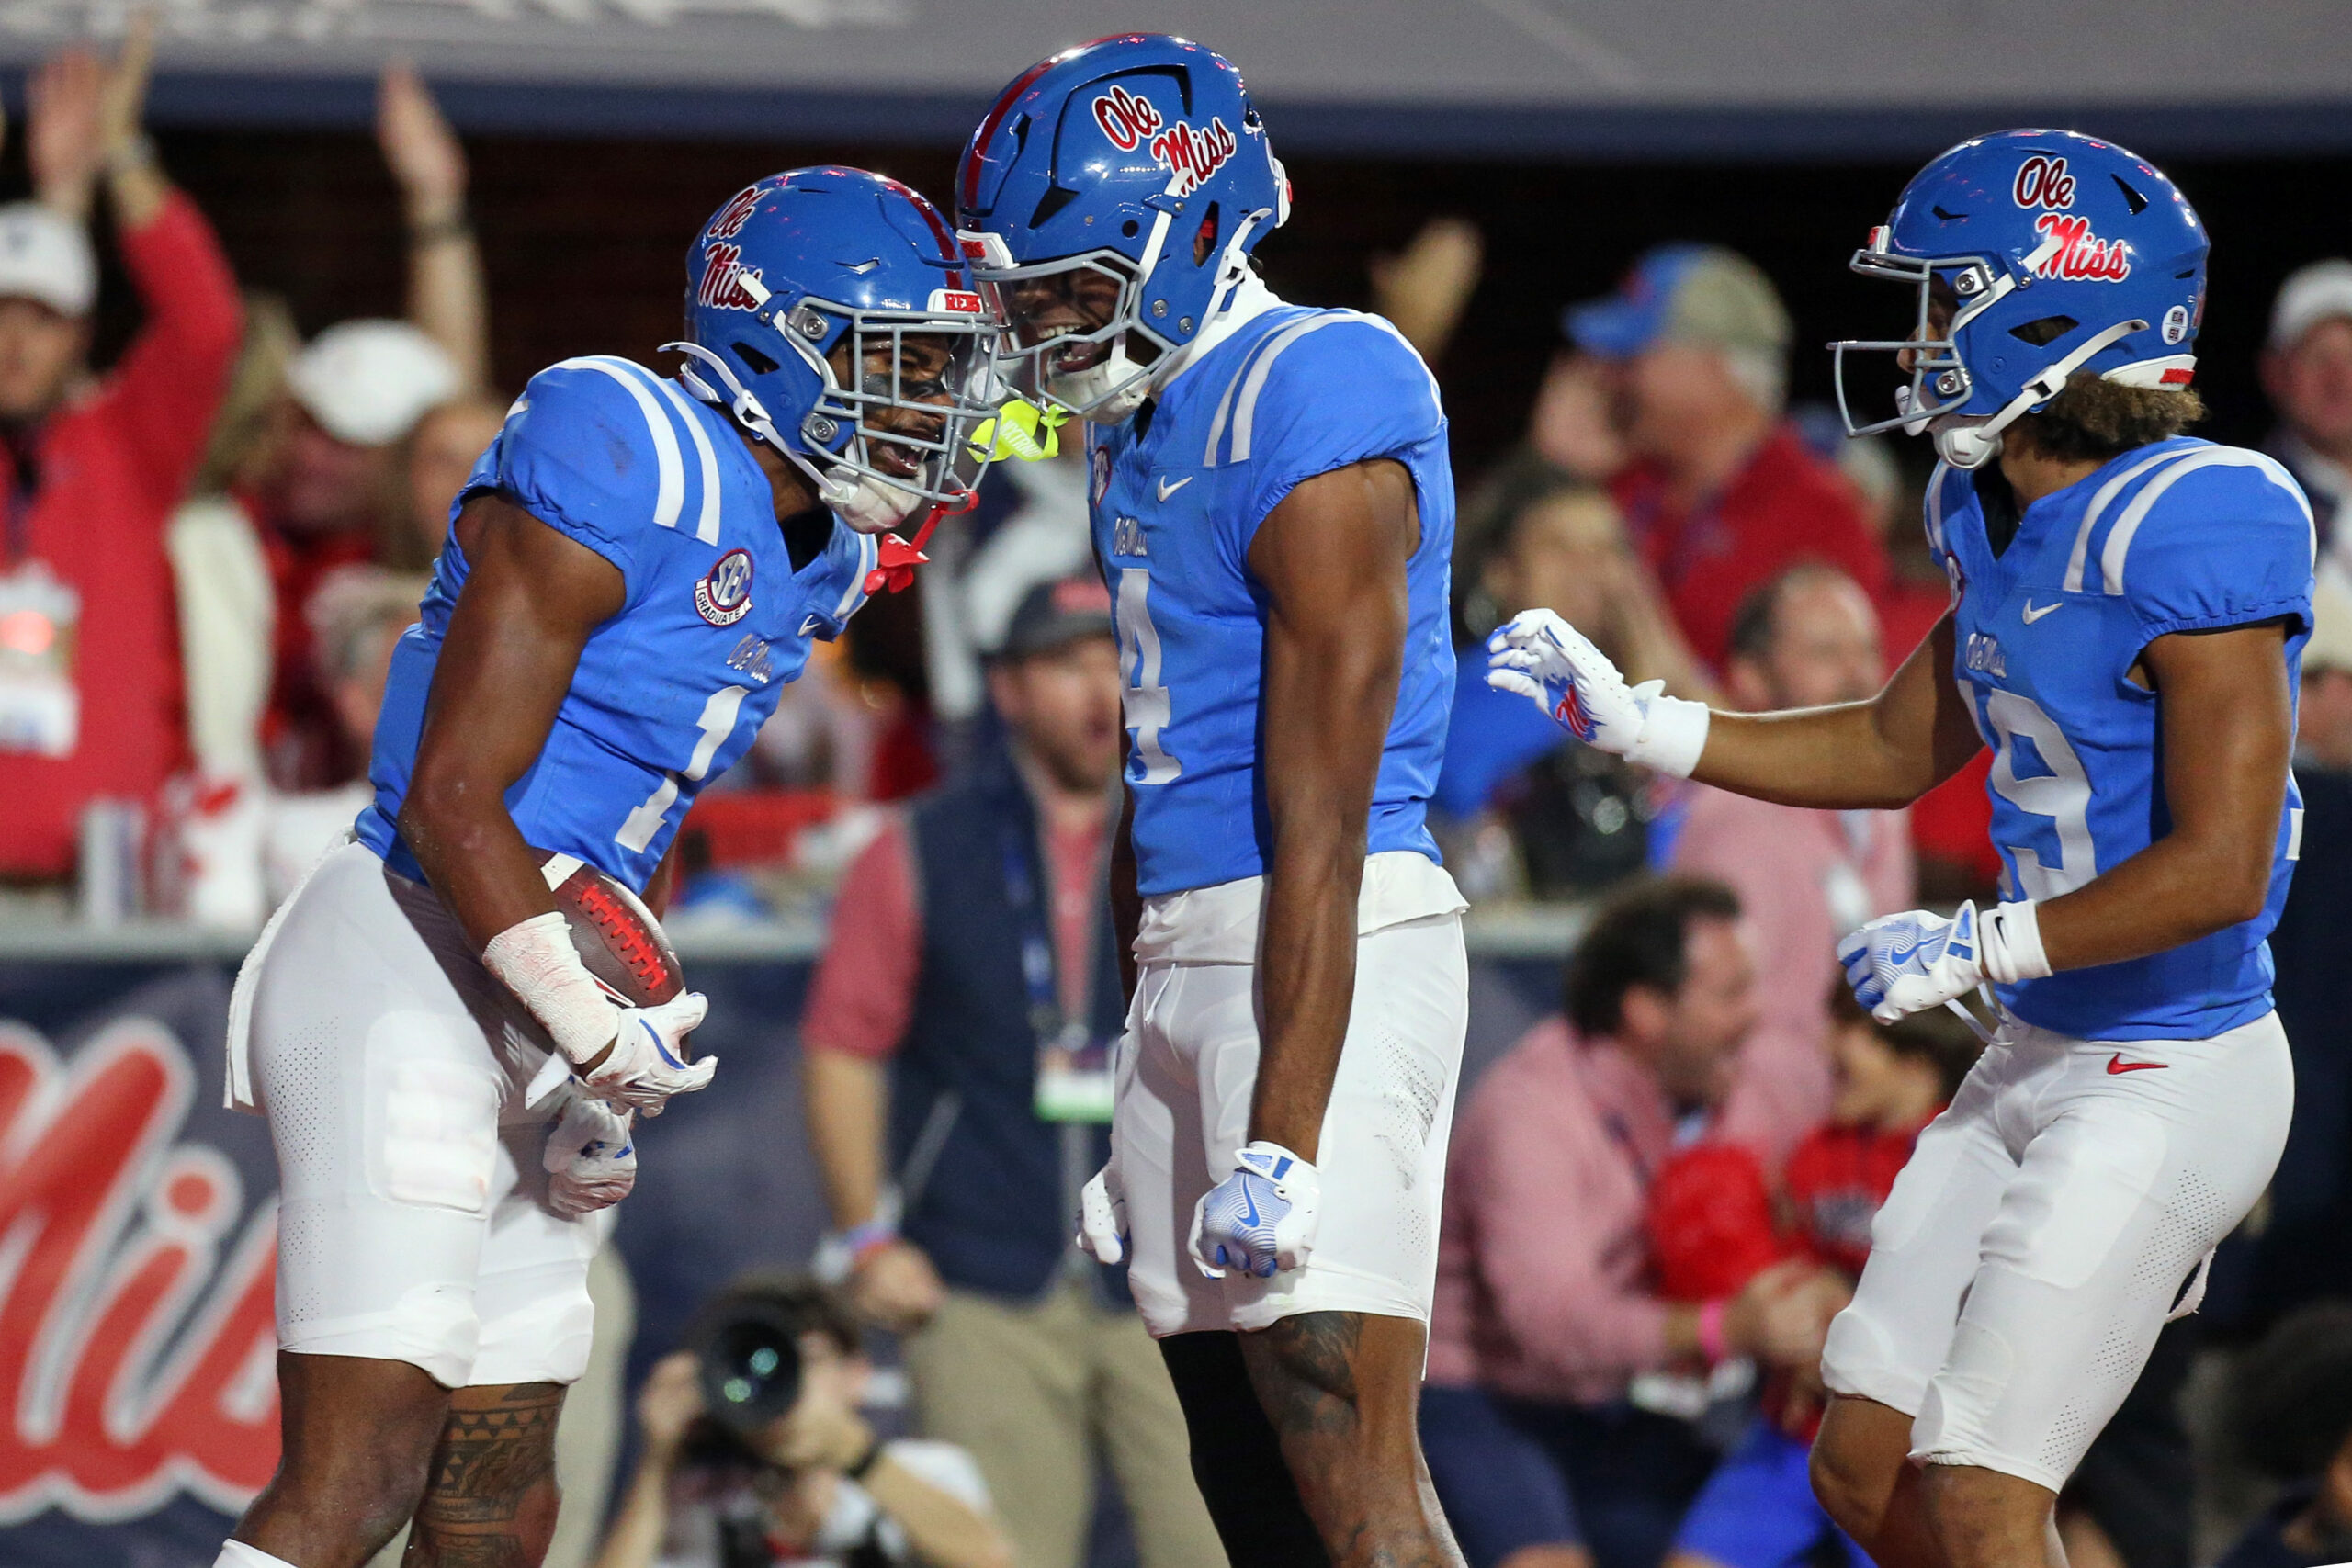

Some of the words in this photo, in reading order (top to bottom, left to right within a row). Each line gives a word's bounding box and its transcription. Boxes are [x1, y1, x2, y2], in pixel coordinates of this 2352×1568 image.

[1091, 85, 1161, 152] Ole
[1150, 116, 1237, 198] Miss
[2013, 156, 2075, 209] Ole
[707, 186, 770, 239] Ole
[698, 241, 763, 312] Miss
[2035, 213, 2131, 283] Miss
[696, 592, 741, 625] GRADUATE
[710, 553, 752, 607] SEC
[1116, 568, 1182, 785] 4
[614, 685, 751, 854] 1
